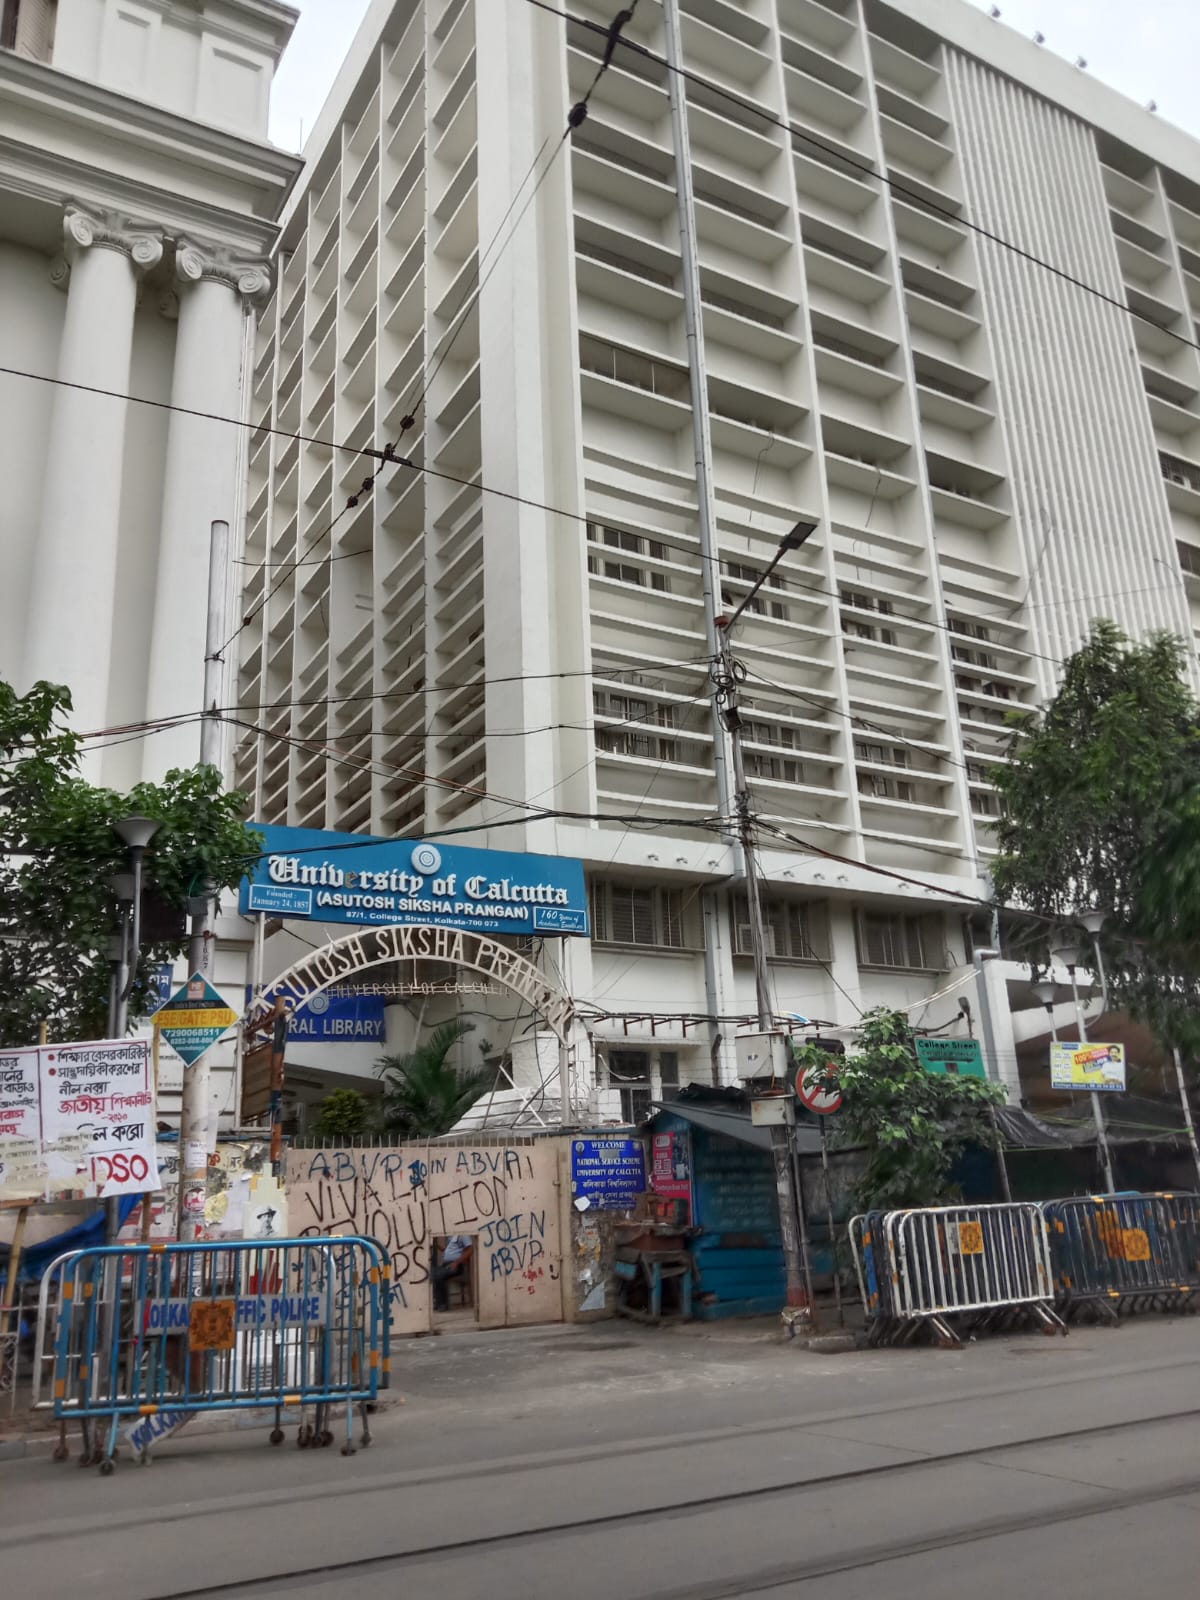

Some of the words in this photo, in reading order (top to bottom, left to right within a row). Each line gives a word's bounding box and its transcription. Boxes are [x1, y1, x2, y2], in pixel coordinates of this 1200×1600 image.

[268, 855, 423, 897] University
[432, 873, 457, 897] of
[465, 875, 569, 905] Calcutta
[252, 896, 280, 908] January
[316, 890, 395, 910] (ASUTOSH
[398, 898, 452, 914] SIKSHA
[454, 902, 529, 920] PRANGAN)
[369, 912, 403, 922] College
[434, 917, 483, 926] Kolkata-700
[540, 909, 557, 920] 160
[375, 926, 464, 961] SIKSHA
[326, 982, 414, 999] UNIVERSITY
[421, 982, 436, 995] OF
[288, 1018, 317, 1035] RAL
[323, 1019, 383, 1036] LIBRARY
[59, 1080, 81, 1096] নীল
[111, 1123, 144, 1142] করো
[591, 1141, 625, 1149] WELCOME
[308, 1152, 402, 1183] ABVP
[607, 1168, 614, 1176] OF
[305, 1177, 382, 1222] VIVA
[298, 1176, 508, 1250] VOLUTION
[478, 1210, 545, 1248] JOIN
[490, 1240, 543, 1282] ABVP
[237, 1299, 266, 1324] FFIC
[271, 1296, 320, 1322] POLICE
